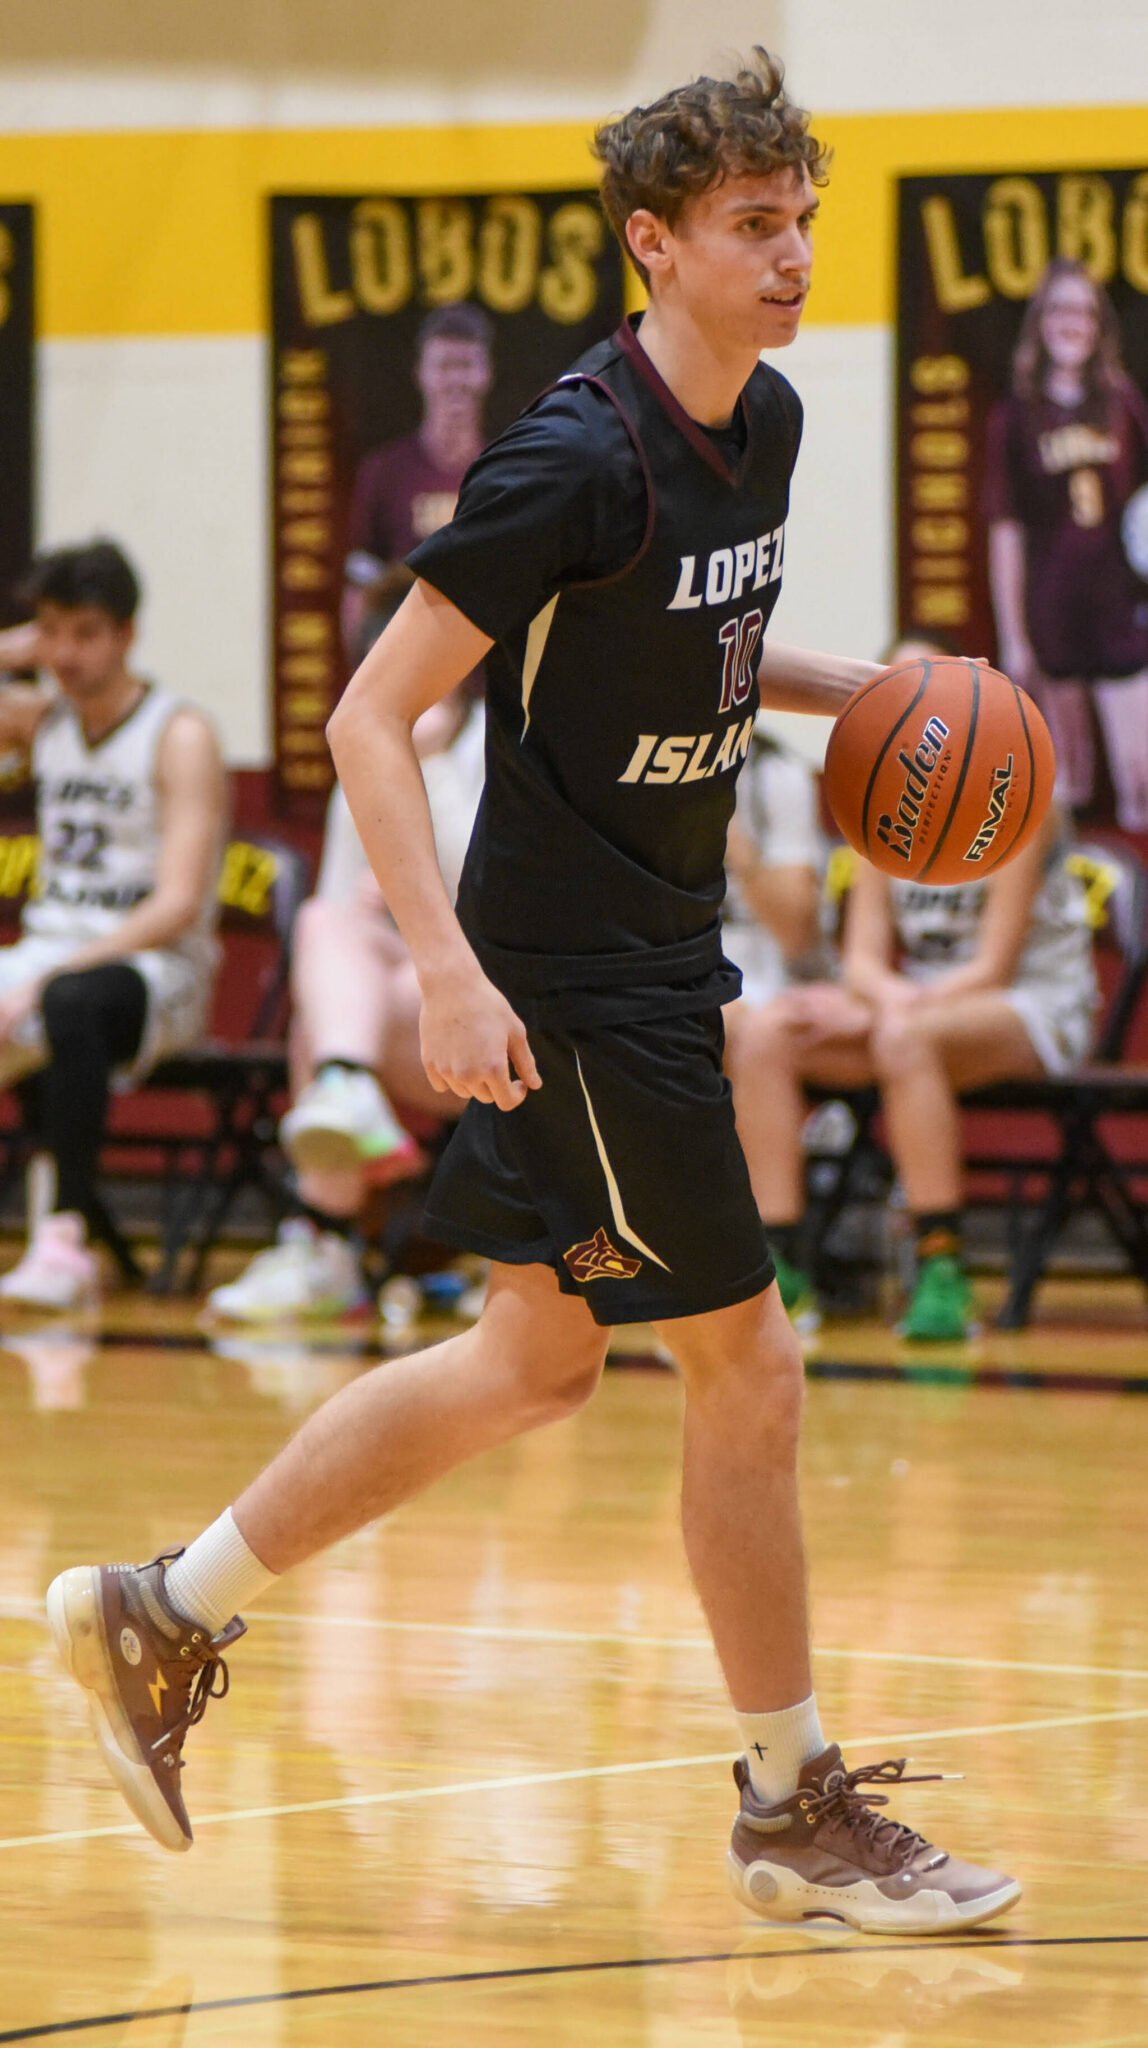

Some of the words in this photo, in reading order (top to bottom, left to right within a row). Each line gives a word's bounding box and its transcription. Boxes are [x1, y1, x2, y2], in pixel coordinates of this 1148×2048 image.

[291, 195, 603, 326] LOBOS
[665, 523, 785, 611] LOPEZ
[717, 607, 763, 714] 10
[876, 716, 950, 862] Baden
[918, 750, 952, 845] PERFECTION
[962, 753, 1014, 862] RIVAL
